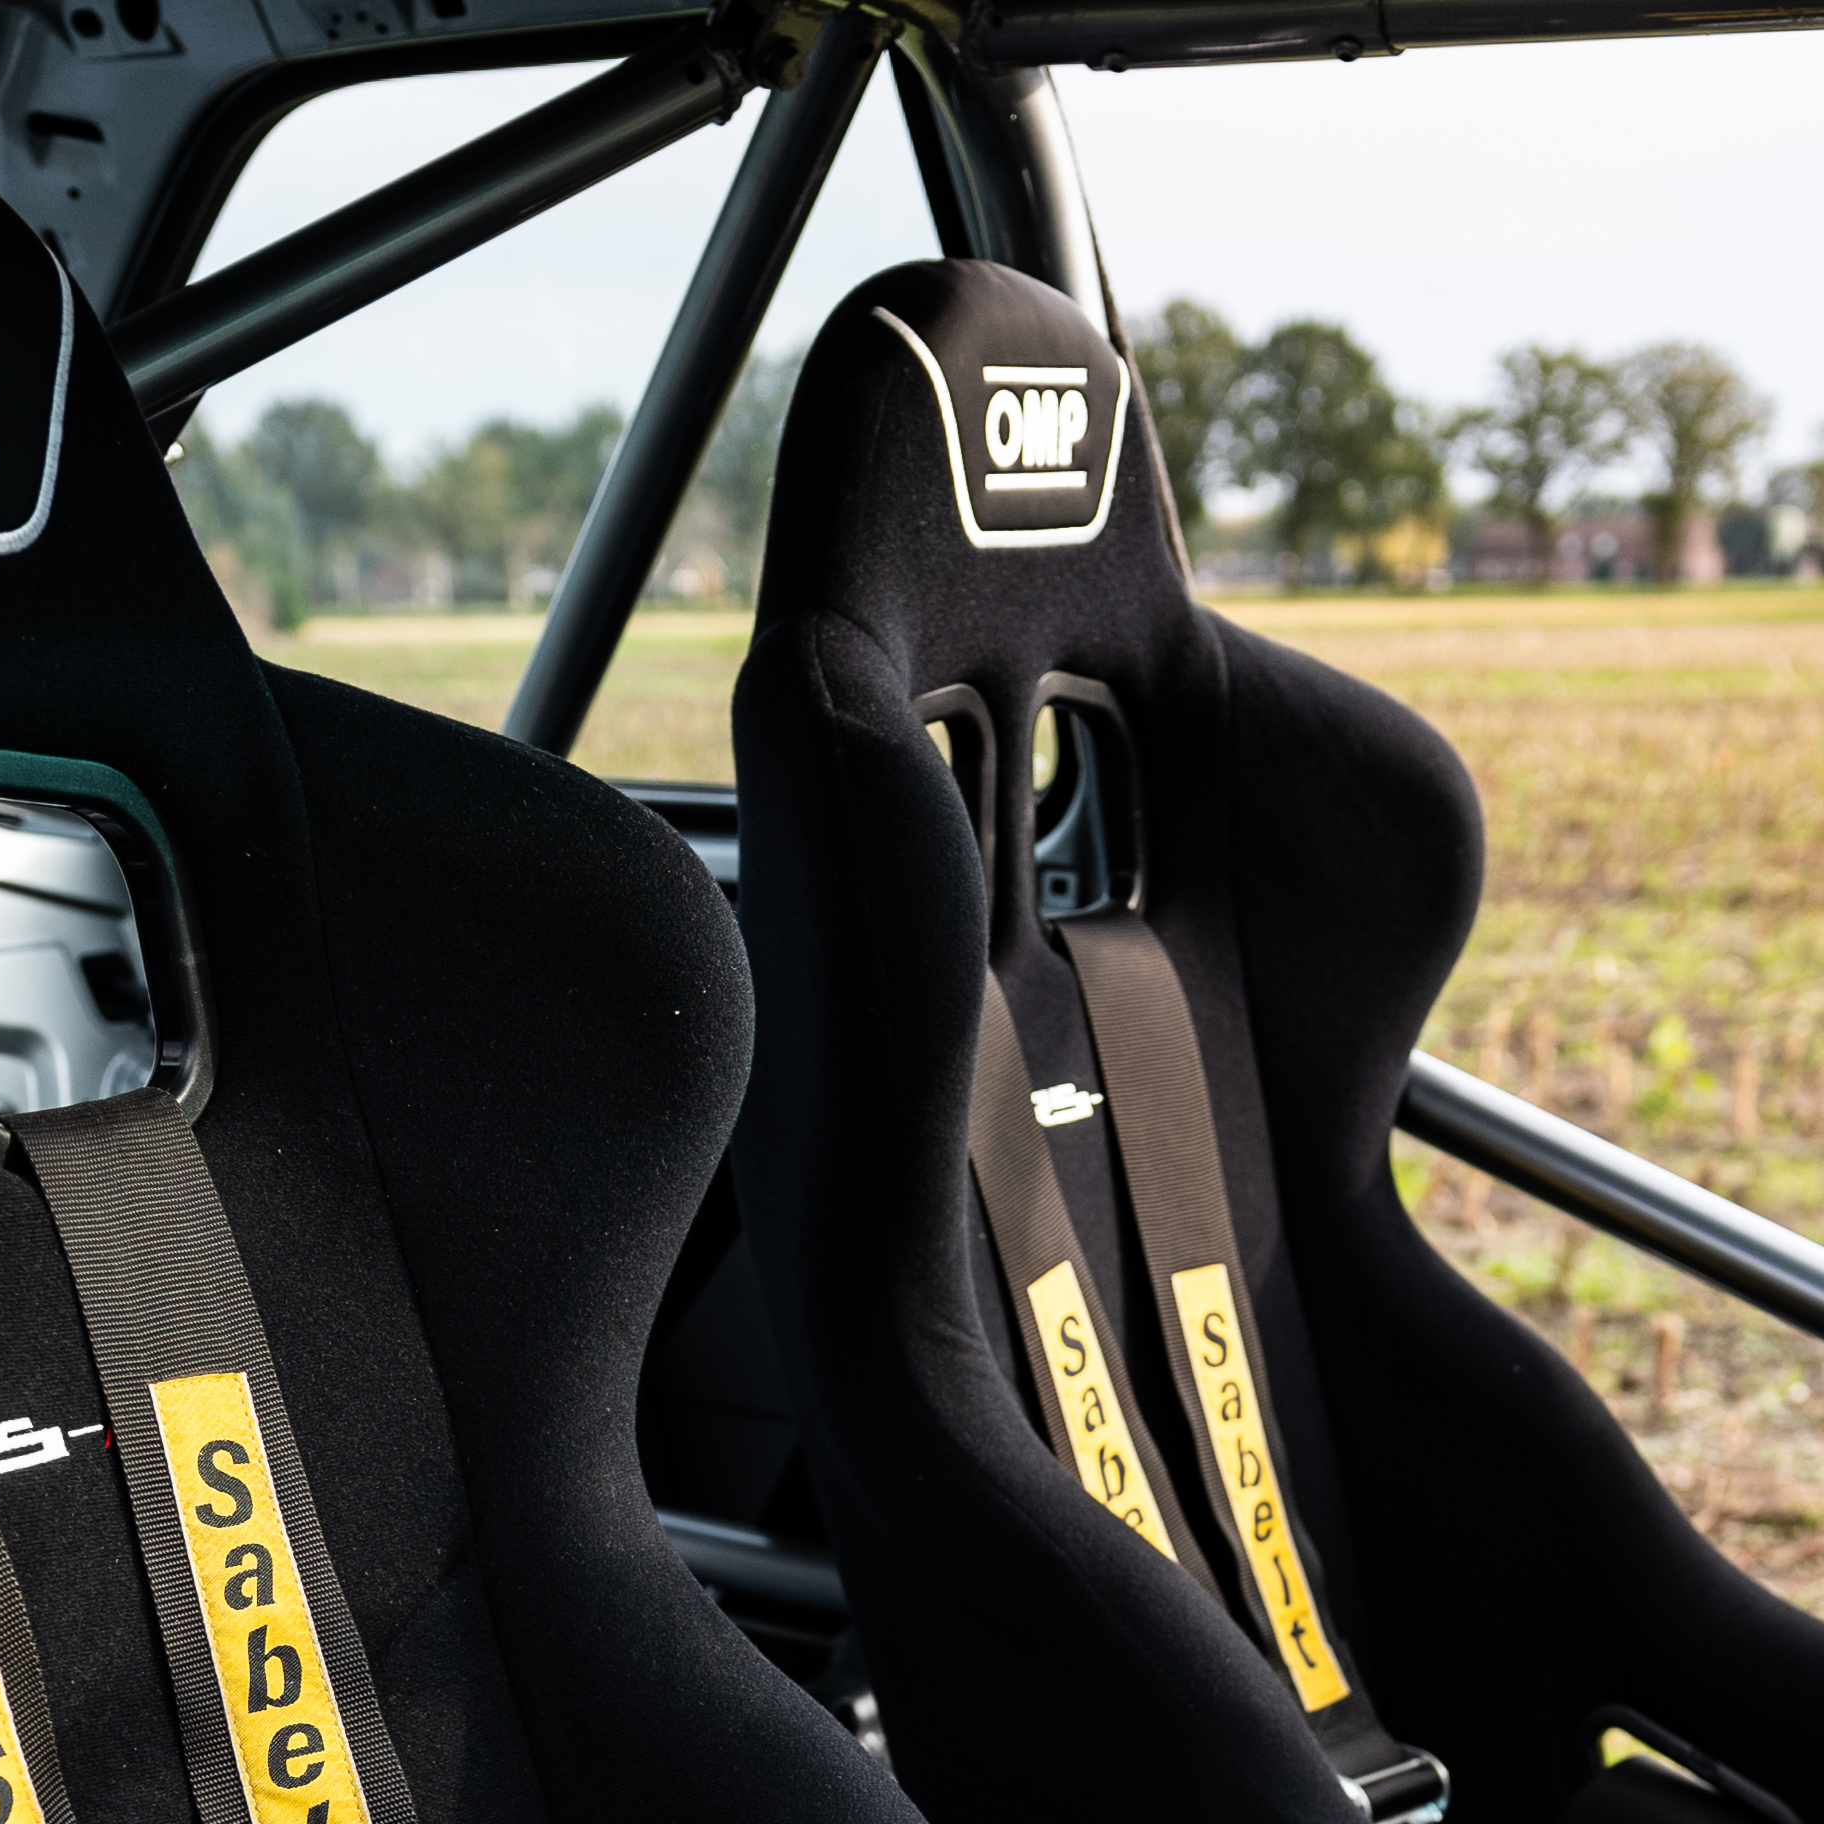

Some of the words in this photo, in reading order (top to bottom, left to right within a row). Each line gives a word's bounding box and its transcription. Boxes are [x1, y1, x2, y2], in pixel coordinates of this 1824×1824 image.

[984, 388, 1089, 469] OMP
[1060, 1315, 1144, 1529] Sab
[1201, 1312, 1316, 1668] Sabelt
